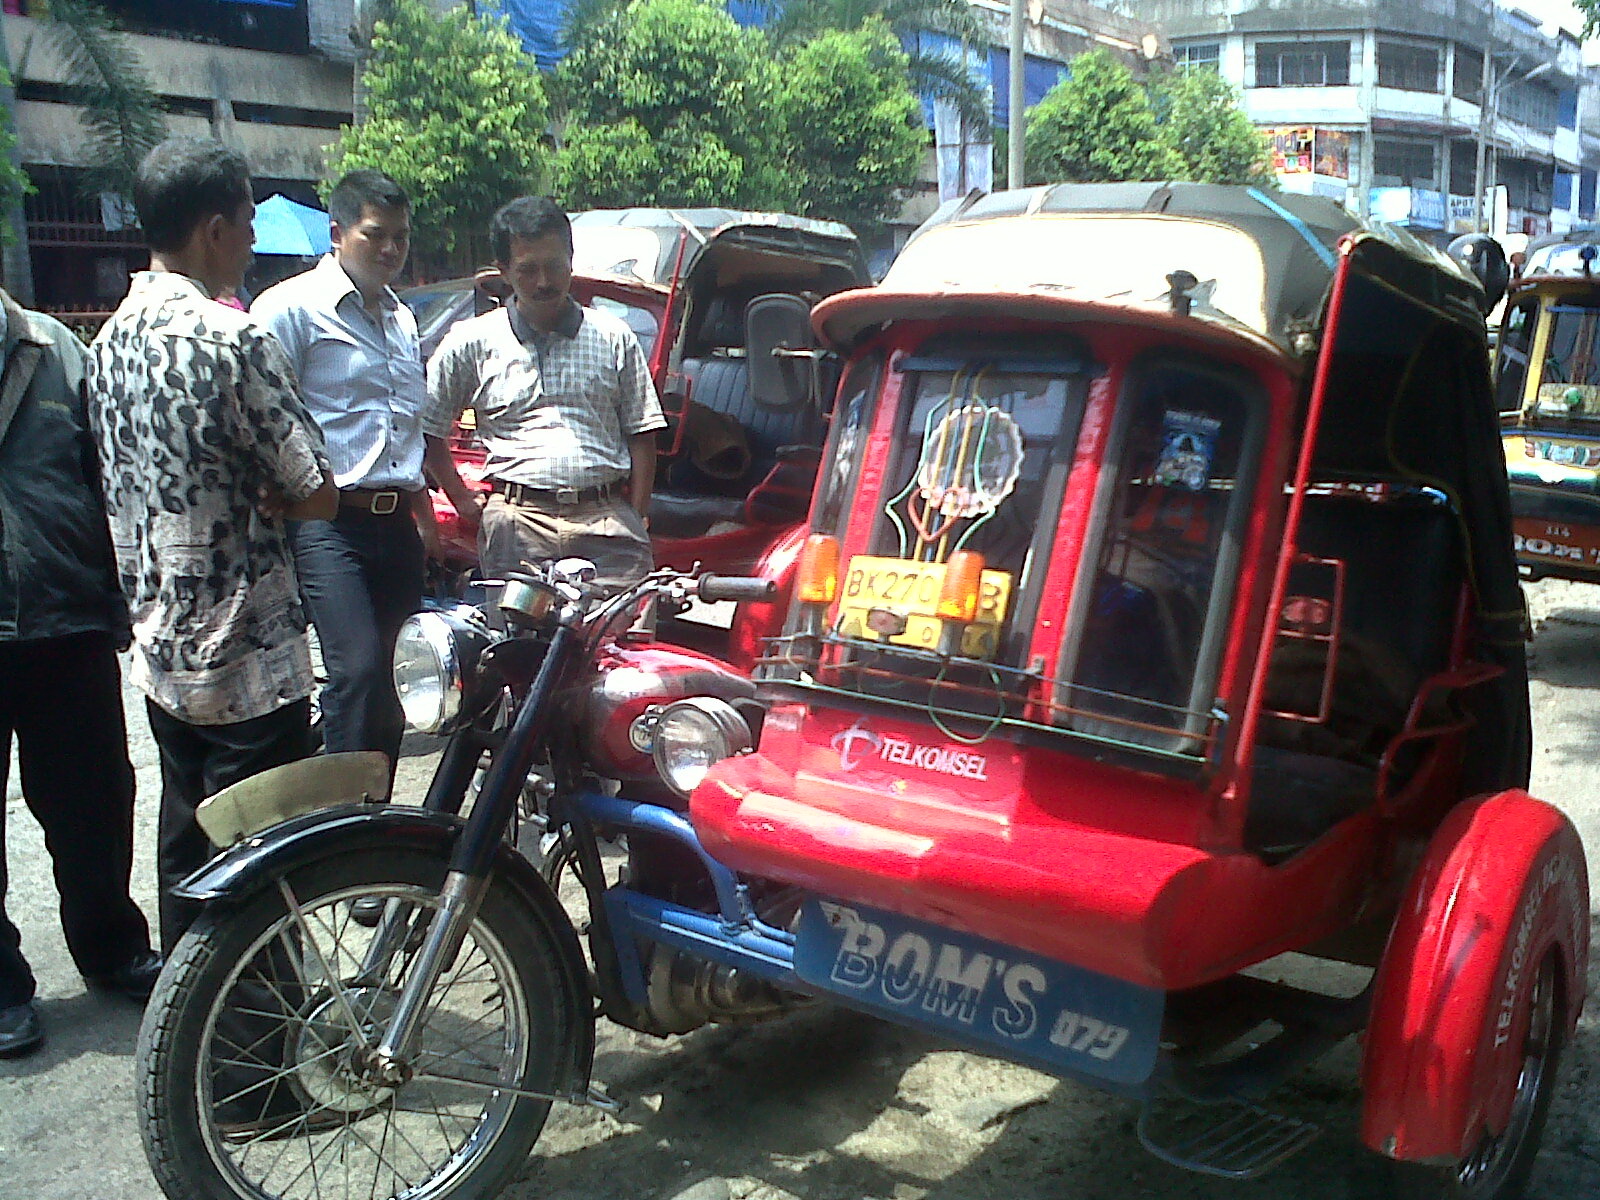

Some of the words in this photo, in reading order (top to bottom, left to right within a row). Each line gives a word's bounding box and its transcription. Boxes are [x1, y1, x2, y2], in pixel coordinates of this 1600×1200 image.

[881, 737, 988, 782] TELKOMSEL
[819, 901, 1046, 1039] BOM'S
[1050, 1010, 1129, 1061] 079
